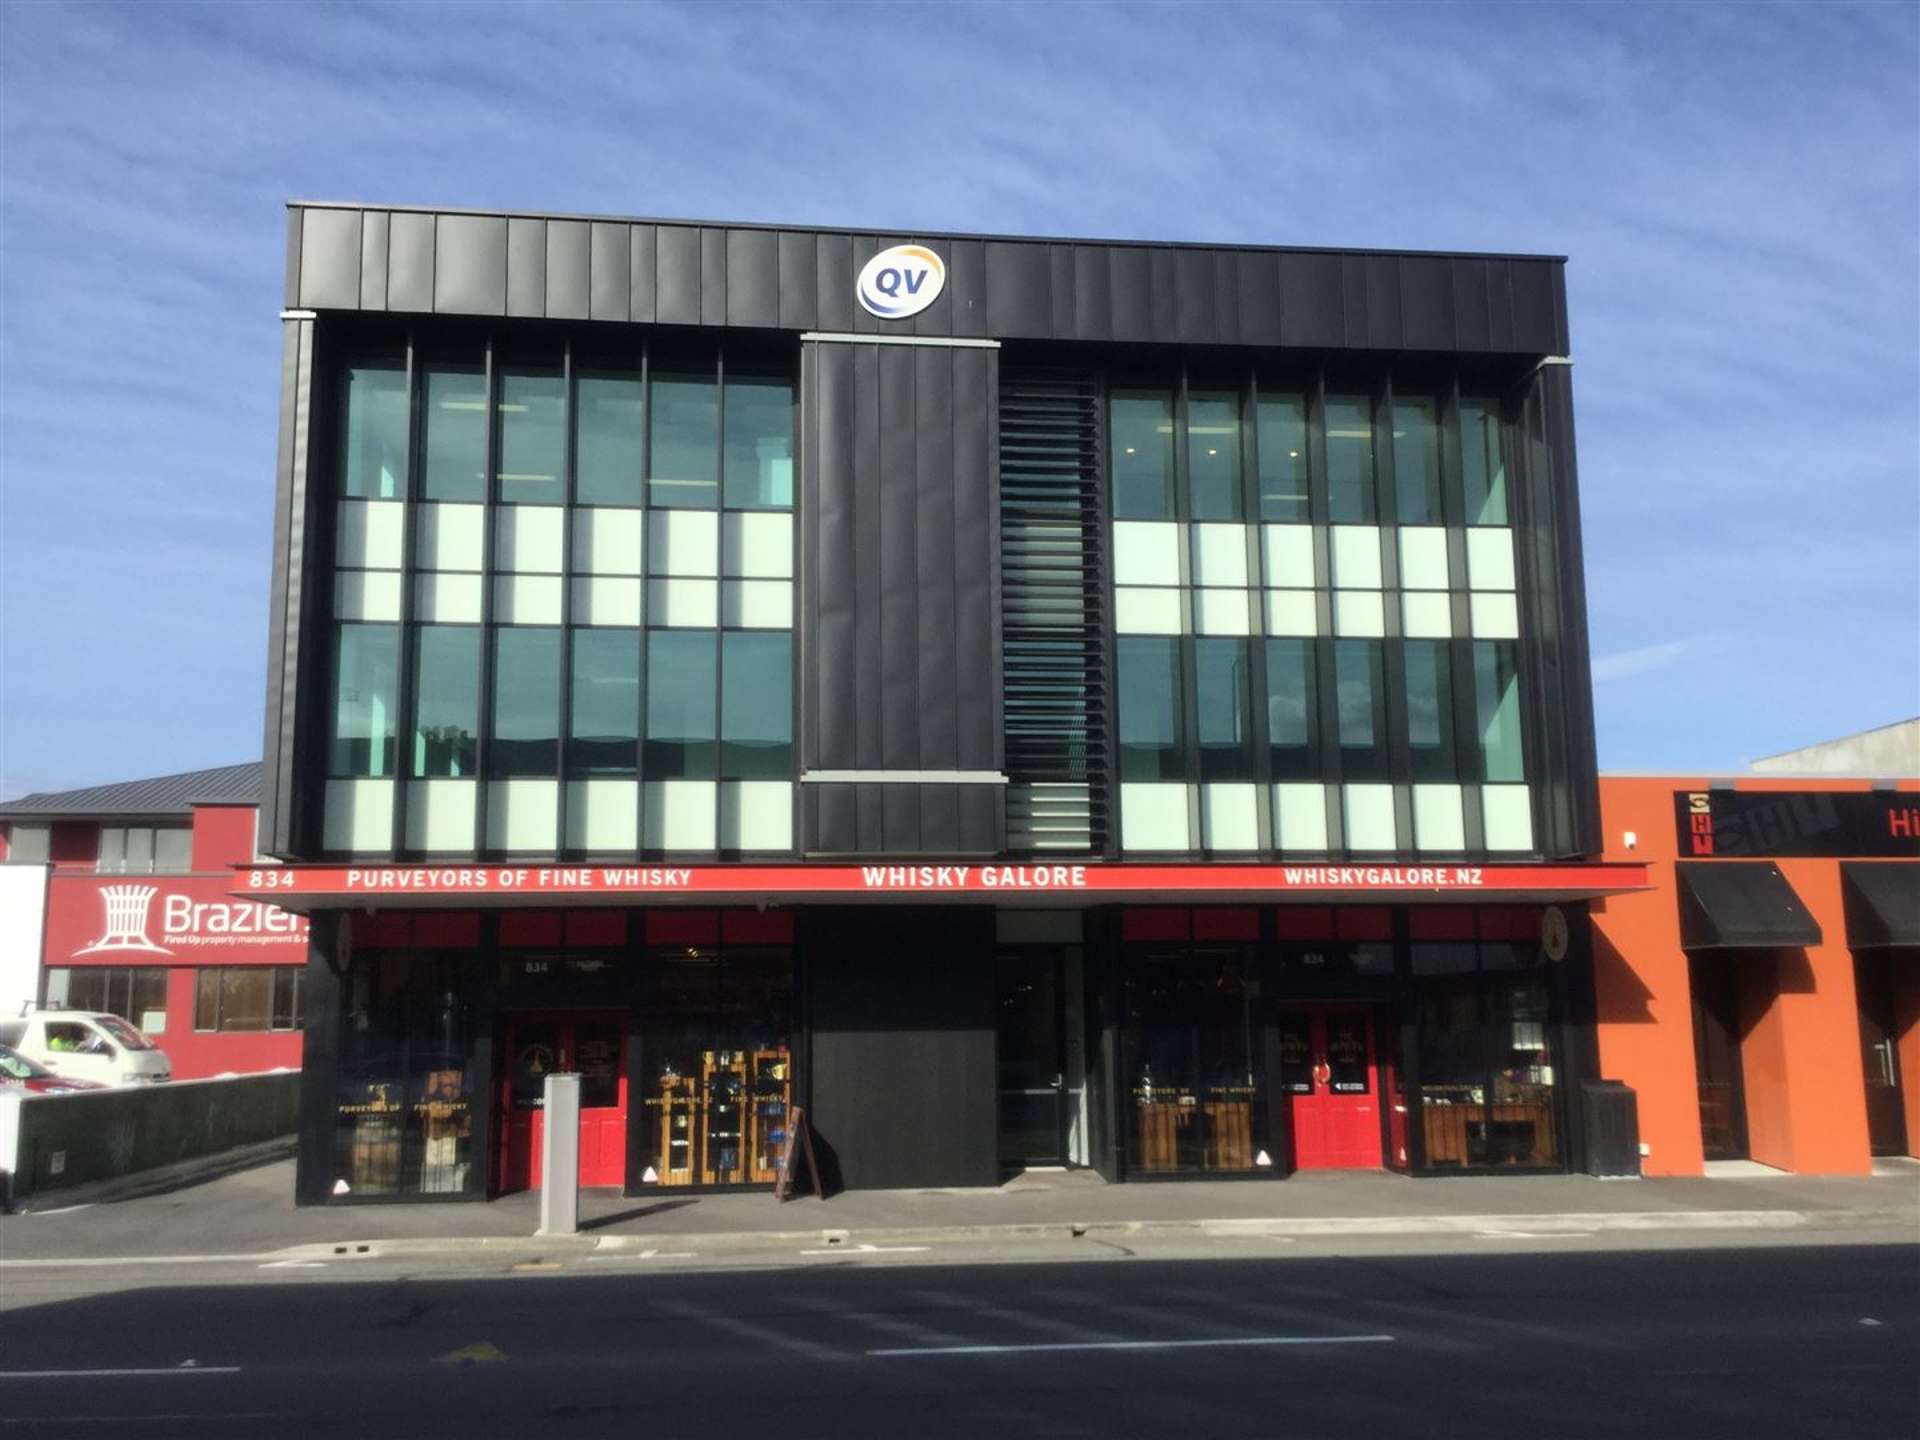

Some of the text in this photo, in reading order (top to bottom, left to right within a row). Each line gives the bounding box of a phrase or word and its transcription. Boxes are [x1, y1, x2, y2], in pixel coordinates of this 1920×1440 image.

[875, 267, 928, 298] QV
[249, 870, 295, 888] 834
[347, 868, 692, 888] PURVEYORS OF FINE WHISKY
[862, 866, 1087, 886] WHISKY GALORE
[1283, 868, 1483, 885] WHISKYGALORE.NZ
[164, 894, 310, 933] Brazier
[201, 936, 237, 946] property
[238, 935, 292, 946] management
